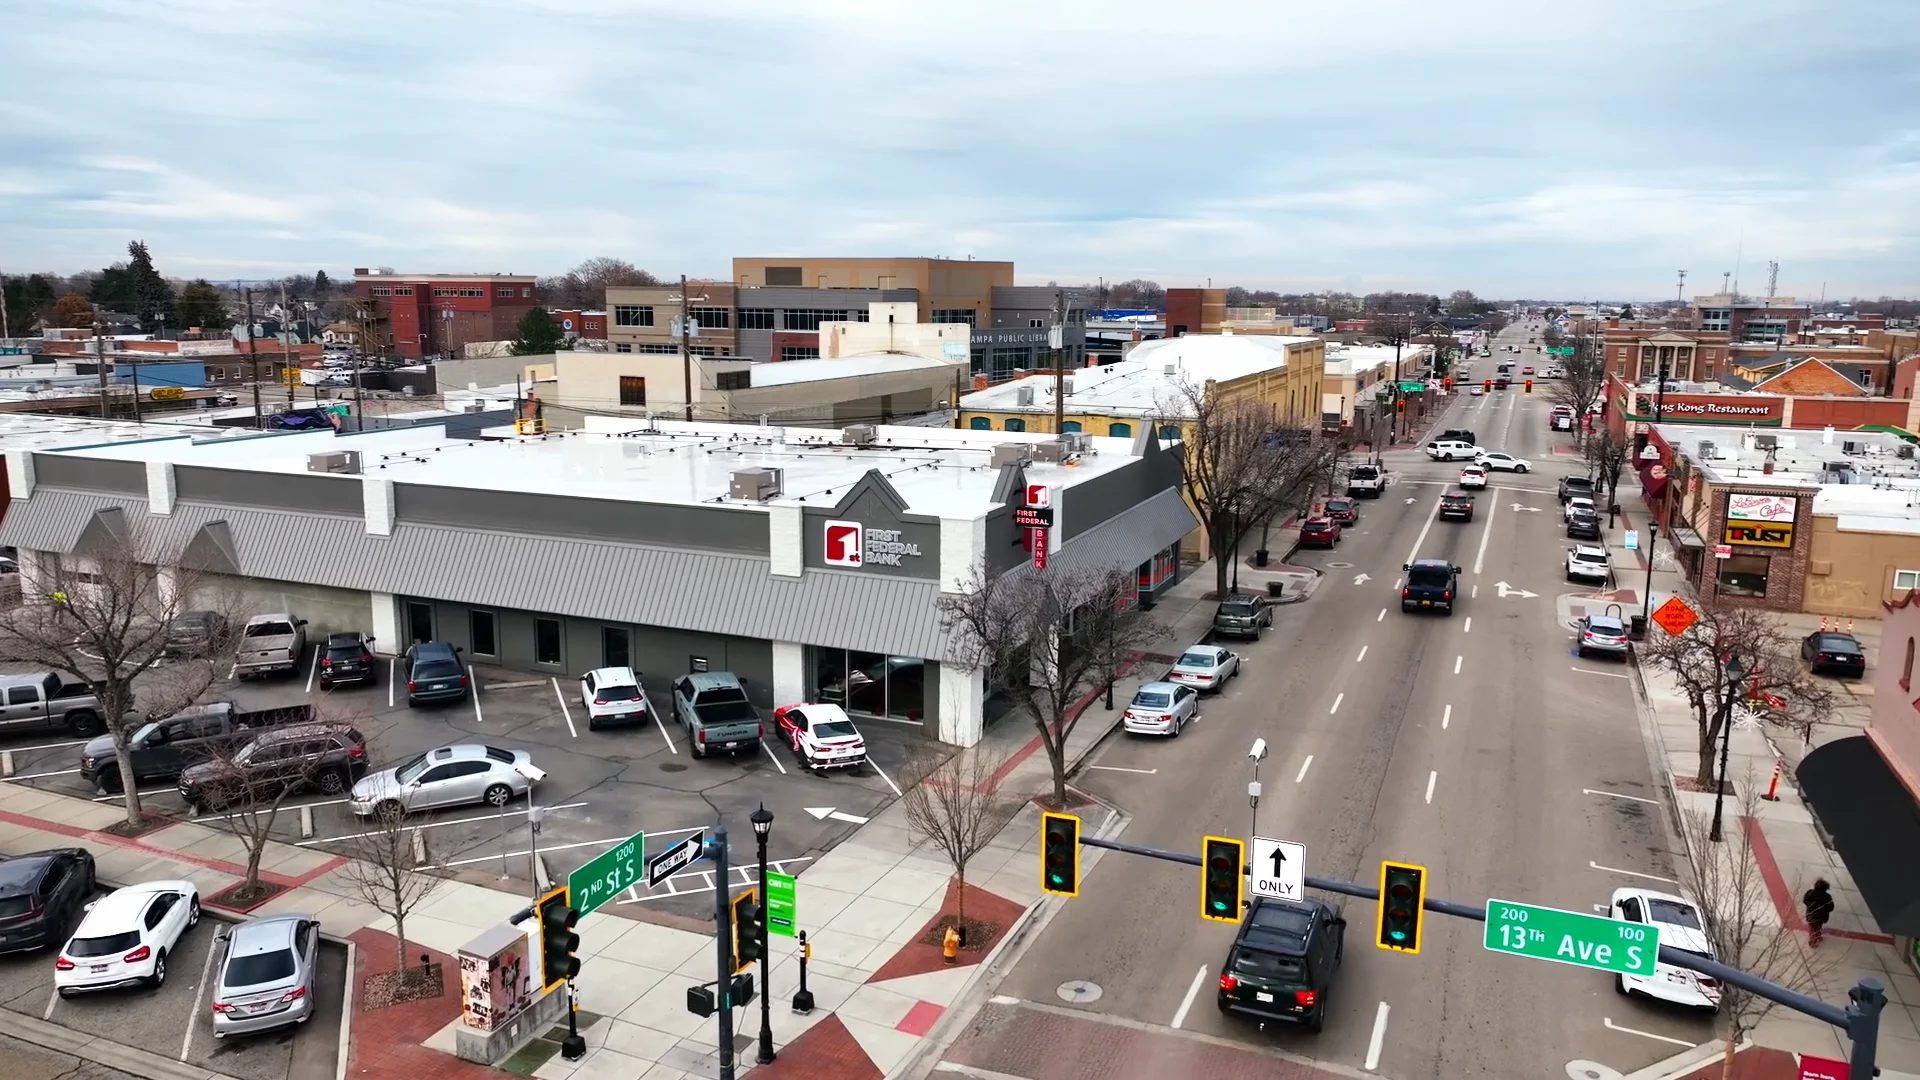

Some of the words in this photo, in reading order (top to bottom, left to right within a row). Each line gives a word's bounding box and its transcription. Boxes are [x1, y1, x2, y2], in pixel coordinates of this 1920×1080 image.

[970, 335, 993, 344] AMPA
[998, 334, 1025, 343] PUBLIC
[1028, 334, 1049, 342] LIBRA
[1677, 402, 1705, 414] Kong
[1707, 403, 1769, 415] Restaurant
[1016, 509, 1038, 517] FIRST
[1016, 517, 1049, 525] FEDERAL
[865, 528, 902, 542] FIRST
[1727, 526, 1791, 543] TRUST
[865, 540, 922, 556] FEDERAL
[1035, 530, 1043, 568] BANK
[865, 552, 902, 567] BANK
[615, 842, 635, 862] 1200
[657, 860, 672, 874] ONE
[673, 848, 688, 864] WAY
[606, 867, 621, 895] St
[625, 859, 634, 883] S
[1259, 880, 1293, 894] ONLY
[1500, 906, 1528, 923] 200
[1618, 927, 1645, 942] 100
[1500, 924, 1545, 949] 13TH
[1557, 934, 1612, 964] Ave
[1625, 945, 1642, 970] S
